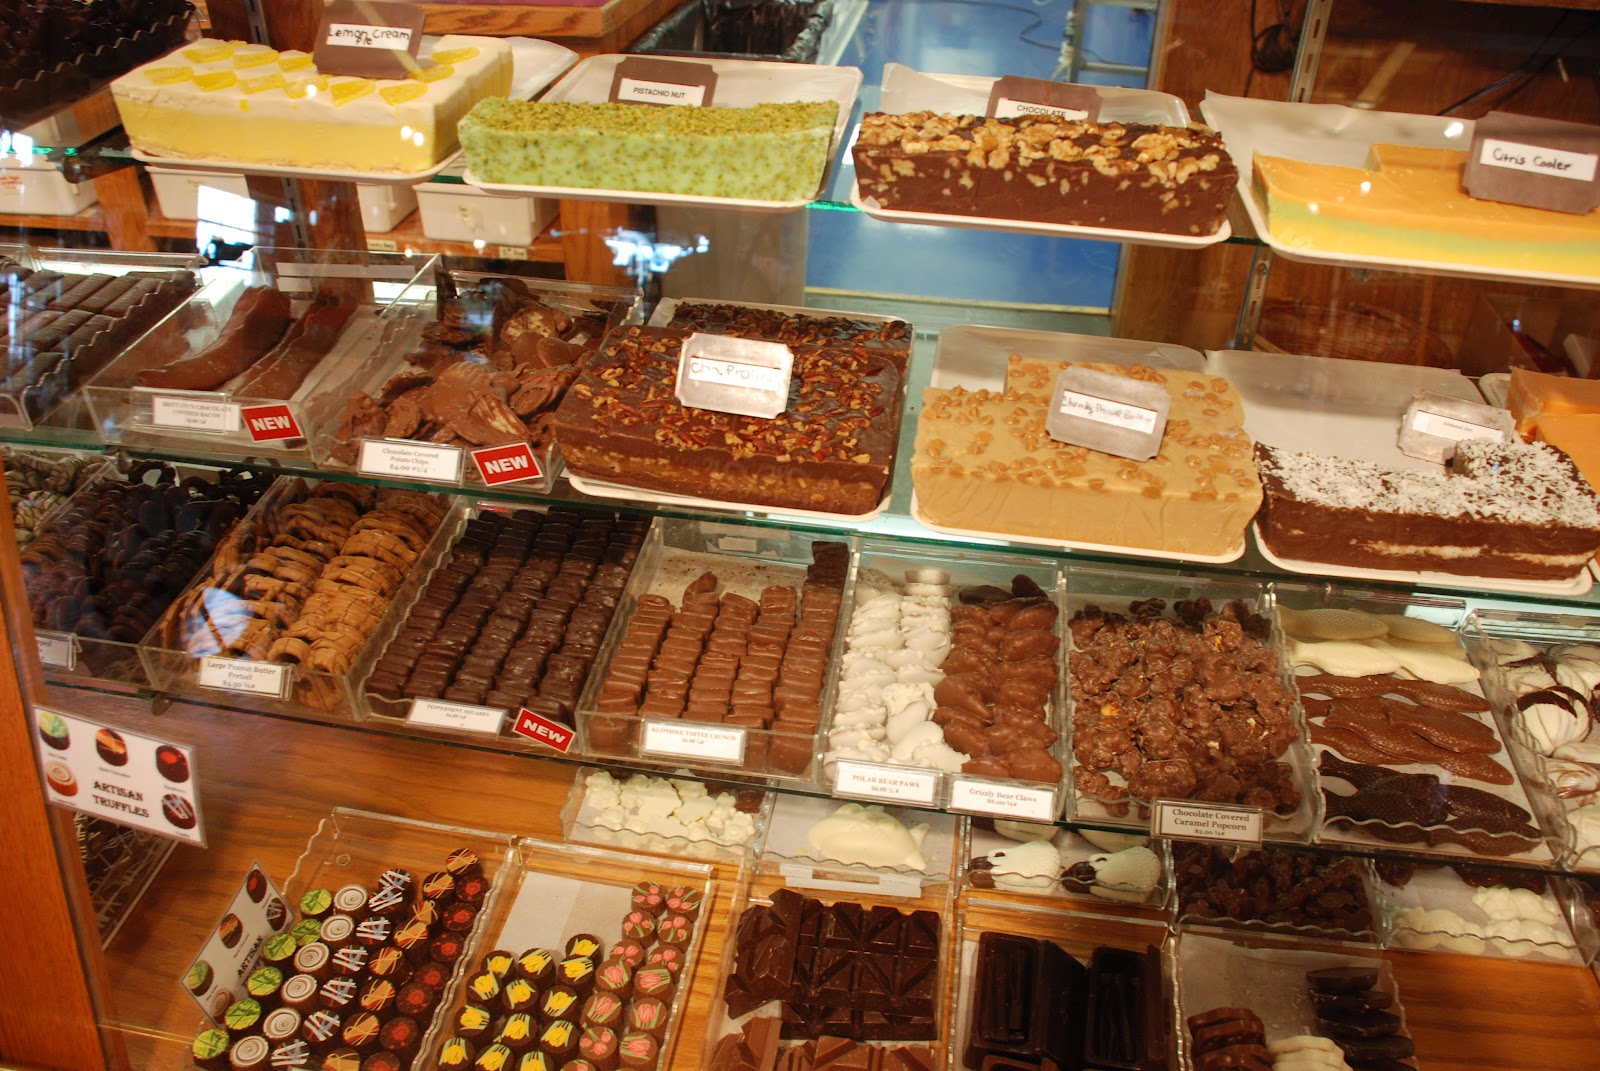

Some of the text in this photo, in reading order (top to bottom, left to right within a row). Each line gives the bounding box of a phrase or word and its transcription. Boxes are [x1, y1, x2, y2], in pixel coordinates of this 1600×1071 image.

[328, 28, 410, 40] Lemon Cream
[633, 87, 670, 97] PISTACHIO
[1533, 155, 1572, 171] Cooler
[251, 415, 292, 431] NEW
[382, 447, 440, 459] Chocolate Covered
[390, 455, 429, 466] Potato Chips
[484, 455, 529, 475] NEW
[207, 661, 276, 675] Large Peanut Butter
[228, 671, 252, 680] Pretzel
[522, 718, 566, 744] NEW
[651, 727, 736, 741] KLONDIKE TOFFEE CRUNCH
[852, 775, 920, 788] POLAR BEAR PAWS
[93, 780, 144, 802] ARTISAN
[969, 788, 1037, 803] Grizzly Bear Claws
[92, 794, 150, 818] TRUFFLES
[1172, 808, 1250, 822] Chocolate Covered
[1174, 817, 1247, 831] Caramel Popcorn
